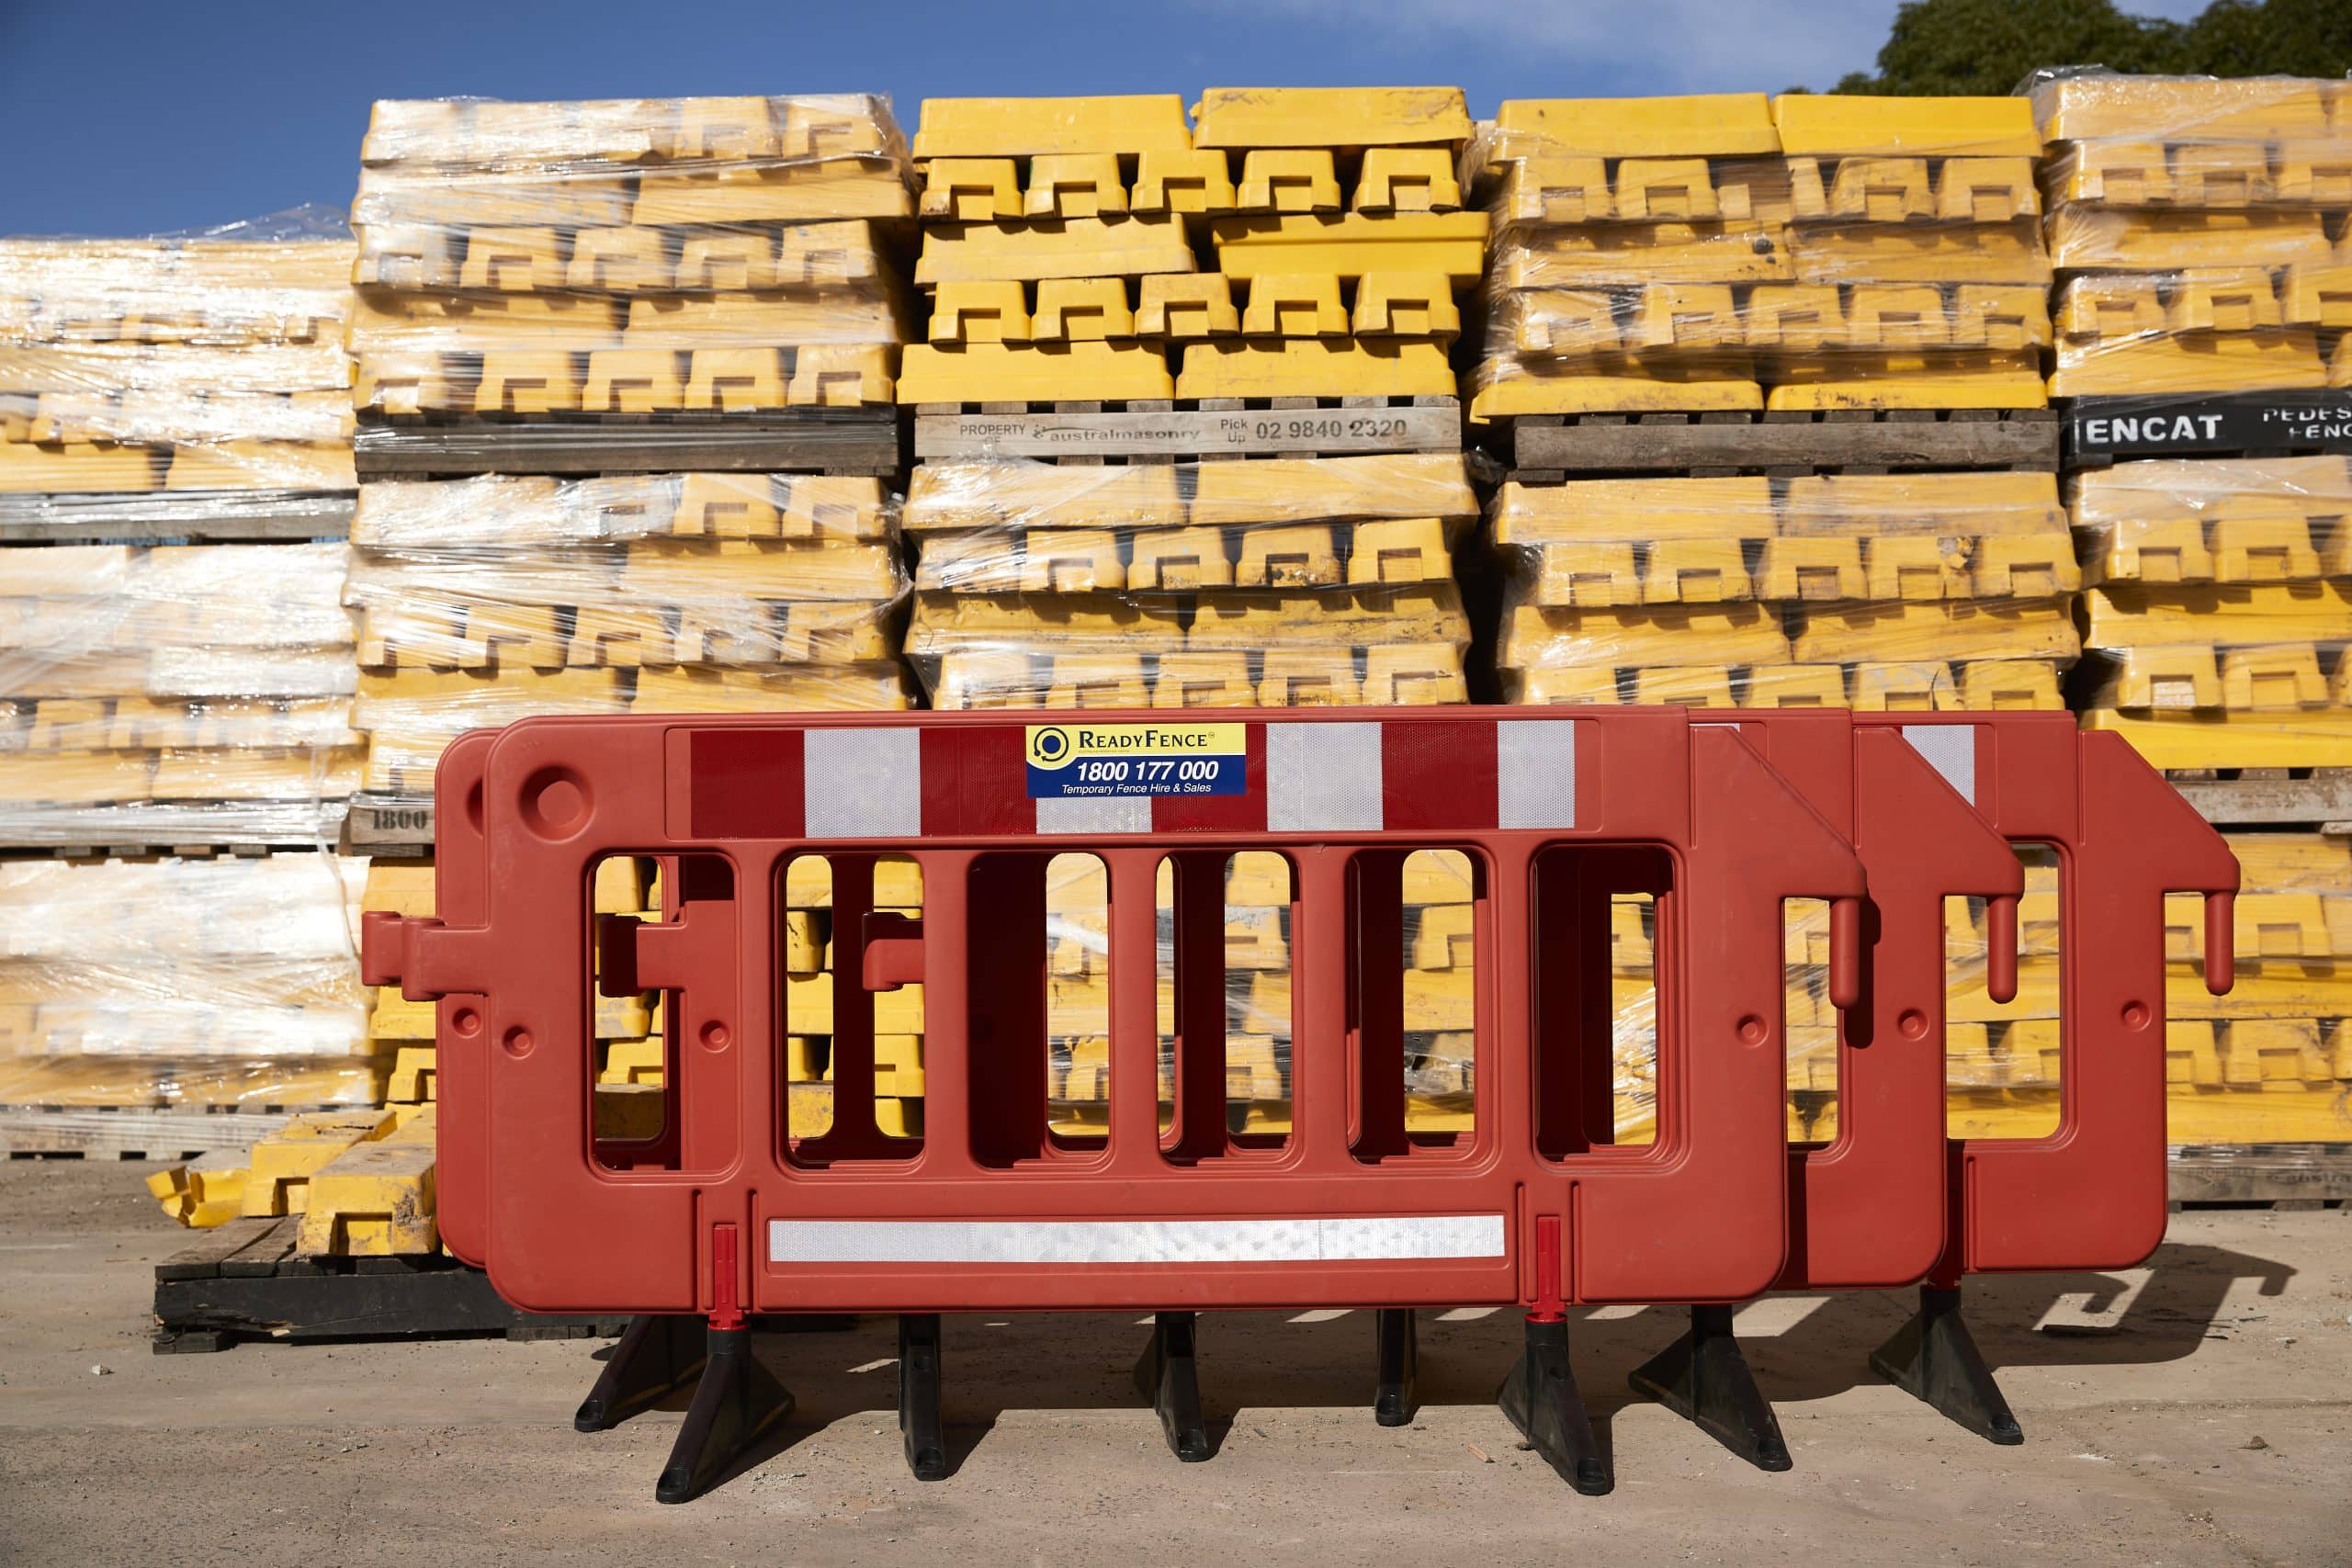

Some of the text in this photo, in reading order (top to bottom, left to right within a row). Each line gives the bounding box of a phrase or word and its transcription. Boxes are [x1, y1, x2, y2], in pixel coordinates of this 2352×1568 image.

[960, 423, 1026, 435] PROPERTY
[1220, 419, 1248, 430] Pick
[1256, 420, 1407, 439] 02 9840 2320
[1050, 428, 1200, 442] australmasonry
[1227, 432, 1246, 445] Up
[1077, 760, 1219, 782] 1800 177 000
[1062, 783, 1212, 795] Temporary Fence Hire & Sales
[372, 808, 428, 830] 1800
